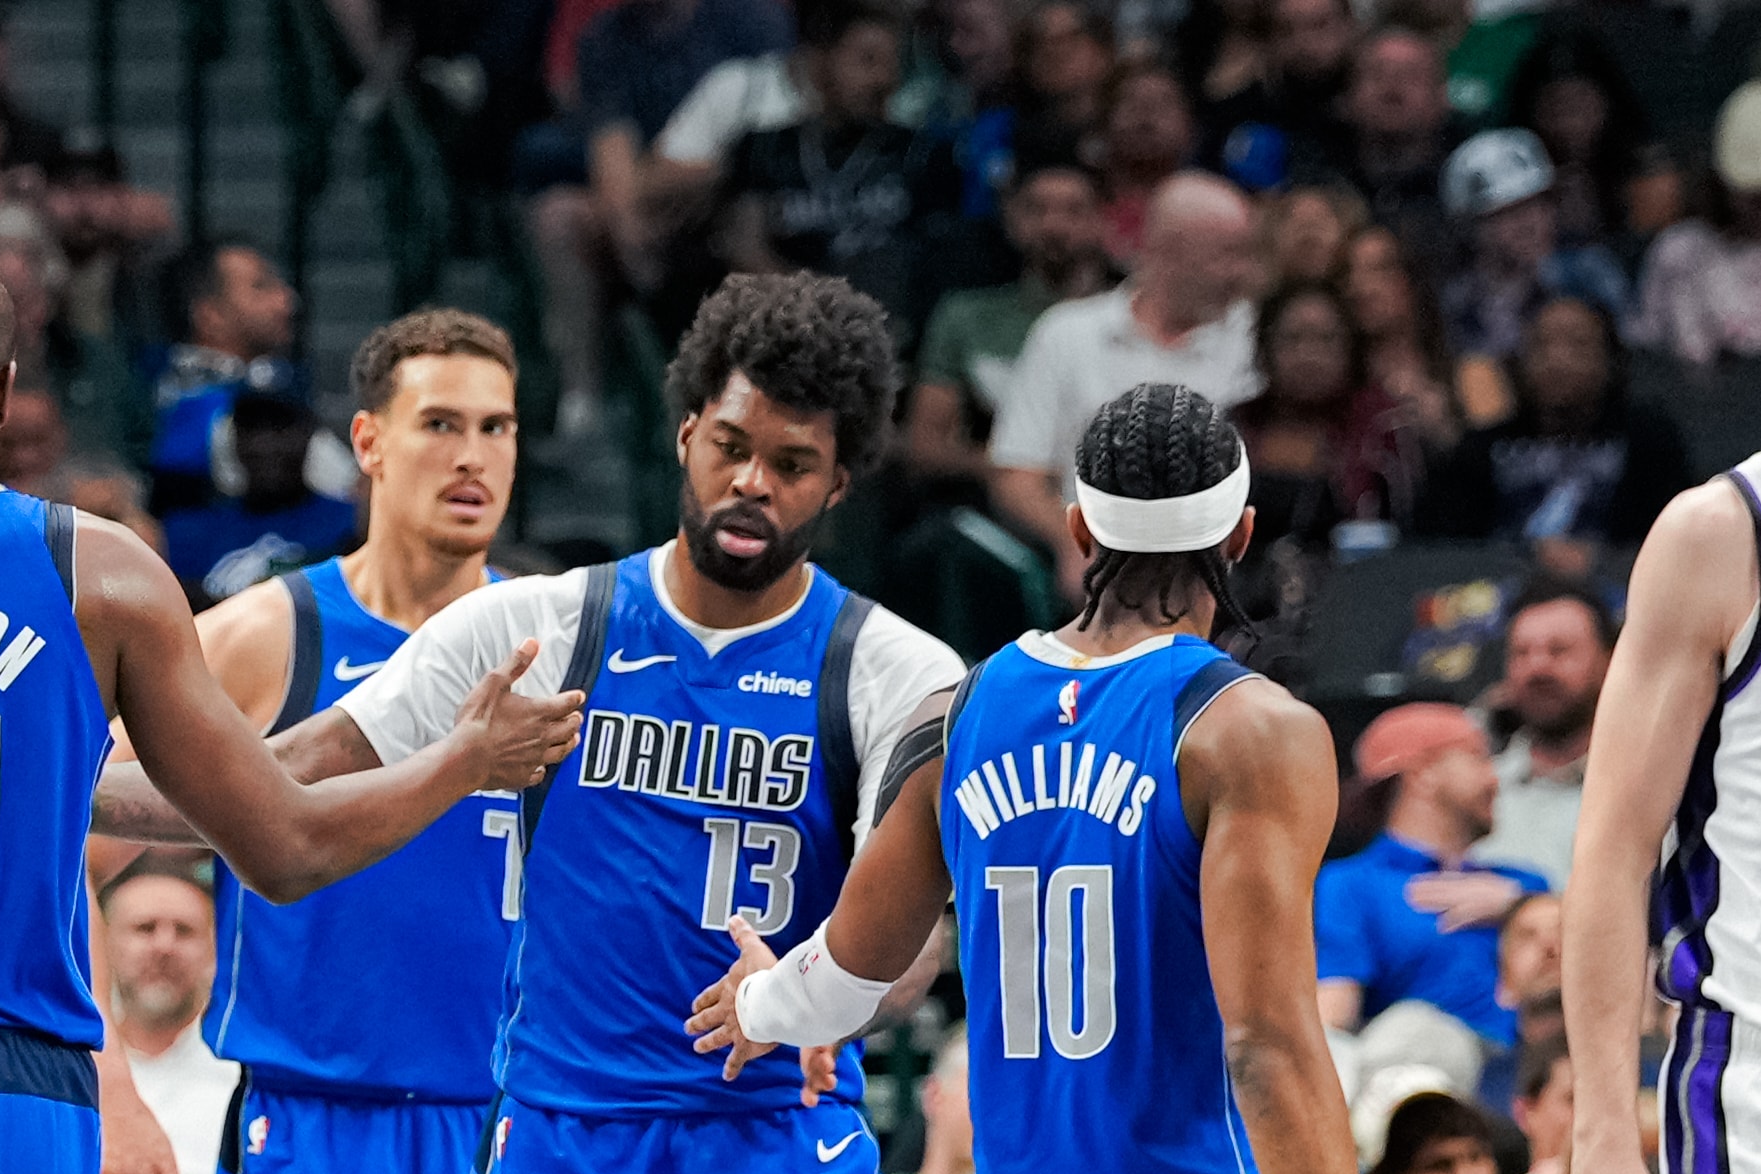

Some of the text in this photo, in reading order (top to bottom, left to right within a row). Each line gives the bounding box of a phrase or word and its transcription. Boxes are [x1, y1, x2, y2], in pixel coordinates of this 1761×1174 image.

[737, 671, 813, 698] chime
[578, 709, 815, 812] DALLAS
[954, 741, 1156, 840] WILLIAMS
[700, 817, 801, 937] 13
[985, 865, 1117, 1060] 10
